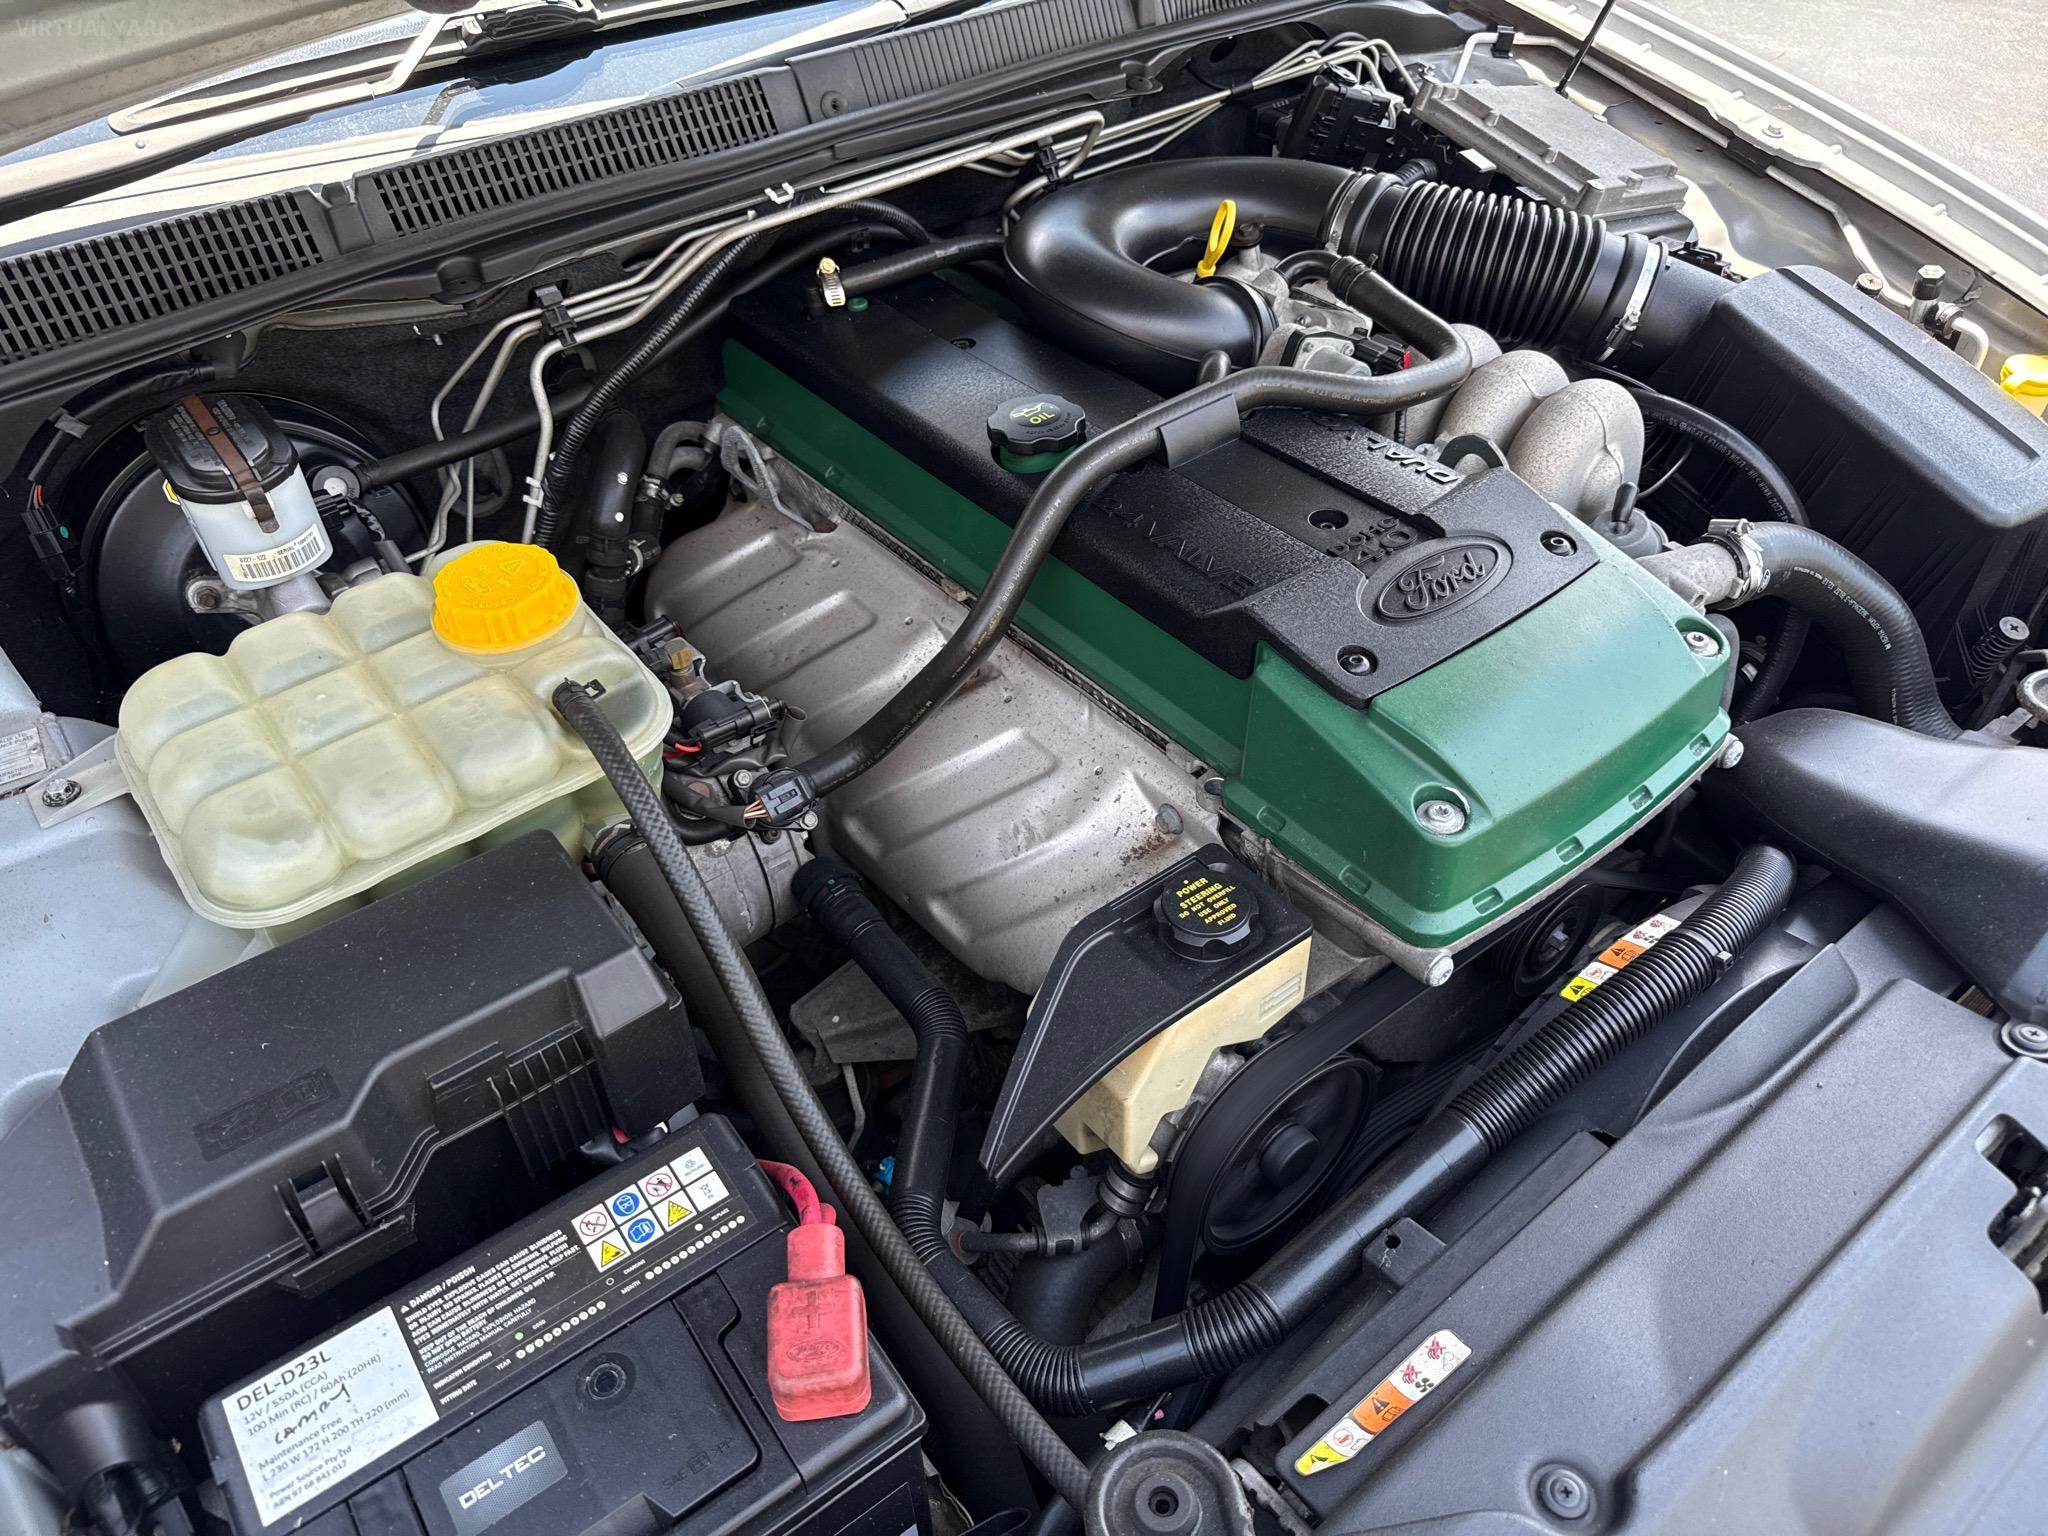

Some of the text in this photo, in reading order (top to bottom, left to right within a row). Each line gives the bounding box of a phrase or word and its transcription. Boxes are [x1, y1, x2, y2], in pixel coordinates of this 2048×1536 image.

[1029, 412, 1056, 424] OIL
[1398, 550, 1486, 611] Ford
[1176, 877, 1209, 898] POWER
[1178, 885, 1237, 919] DO NOT OVERFILL
[1179, 882, 1223, 910] STEERING
[1198, 897, 1230, 918] USE ONLY
[1204, 903, 1237, 924] APPROVED
[1217, 912, 1237, 926] FLUID
[404, 1307, 428, 1323] SHIELD
[443, 1278, 476, 1301] EXPLOSIVE
[475, 1266, 496, 1282] GASES
[494, 1259, 510, 1271] CAN
[508, 1247, 529, 1263] CAUSE
[528, 1229, 562, 1251] BLINDNESS
[407, 1321, 419, 1331] OR
[442, 1300, 454, 1310] NO
[477, 1272, 502, 1290] FLAMES
[501, 1266, 512, 1275] OR
[539, 1234, 568, 1253] SULFURIC
[408, 1284, 442, 1308] DANGER
[445, 1265, 476, 1287] POISON
[411, 1325, 428, 1338] ACID
[426, 1316, 442, 1329] CAN
[440, 1304, 462, 1320] CAUSE
[461, 1284, 497, 1308] BLINDNESS
[496, 1278, 507, 1287] OR
[505, 1265, 528, 1282] SEVERE
[548, 1242, 568, 1257] FLUSH
[413, 1331, 431, 1345] EYES
[430, 1307, 471, 1335] IMMEDIATELY
[470, 1297, 489, 1311] WITH
[509, 1277, 523, 1288] GET
[521, 1262, 550, 1281] MEDICAL
[548, 1253, 564, 1266] HELP
[620, 1279, 641, 1294] MONTH
[418, 1342, 435, 1355] KEEP
[433, 1334, 447, 1346] OUT
[446, 1329, 455, 1338] OF
[454, 1322, 470, 1333] THE
[466, 1311, 488, 1327] REACH
[486, 1306, 495, 1315] OF
[522, 1283, 534, 1293] DO
[531, 1276, 545, 1287] NOT
[423, 1345, 456, 1368] CORROSIVE
[481, 1311, 515, 1333] EXPLOSION
[512, 1297, 536, 1316] HAZARD
[426, 1307, 532, 1374] READ INSTRUCTION MANUAL CAREFULLY
[420, 1351, 432, 1361] DO
[429, 1343, 444, 1355] NOT
[444, 1333, 462, 1347] OPEN
[432, 1368, 463, 1390] INDICATOR
[461, 1350, 492, 1372] CONDITION
[236, 1350, 331, 1411] DEL-D23L
[243, 1370, 328, 1425] 12V / 550A (CCA)
[247, 1353, 381, 1437] 100 Min (RC) / 60Ah (20HR)
[461, 1379, 478, 1392] DATE
[495, 1358, 512, 1370] YEAR
[257, 1416, 342, 1471] Maintenance Free
[269, 1460, 289, 1478] 230
[288, 1453, 300, 1465] W
[302, 1441, 321, 1458] 172
[321, 1436, 330, 1446] H
[330, 1424, 350, 1441] 200
[349, 1415, 364, 1428] TH
[364, 1404, 384, 1420] 220
[383, 1388, 410, 1410] (mm)
[268, 1445, 352, 1499] Power Source Pty Ltd
[331, 1458, 347, 1474] 017
[456, 1445, 547, 1510] DELTEC
